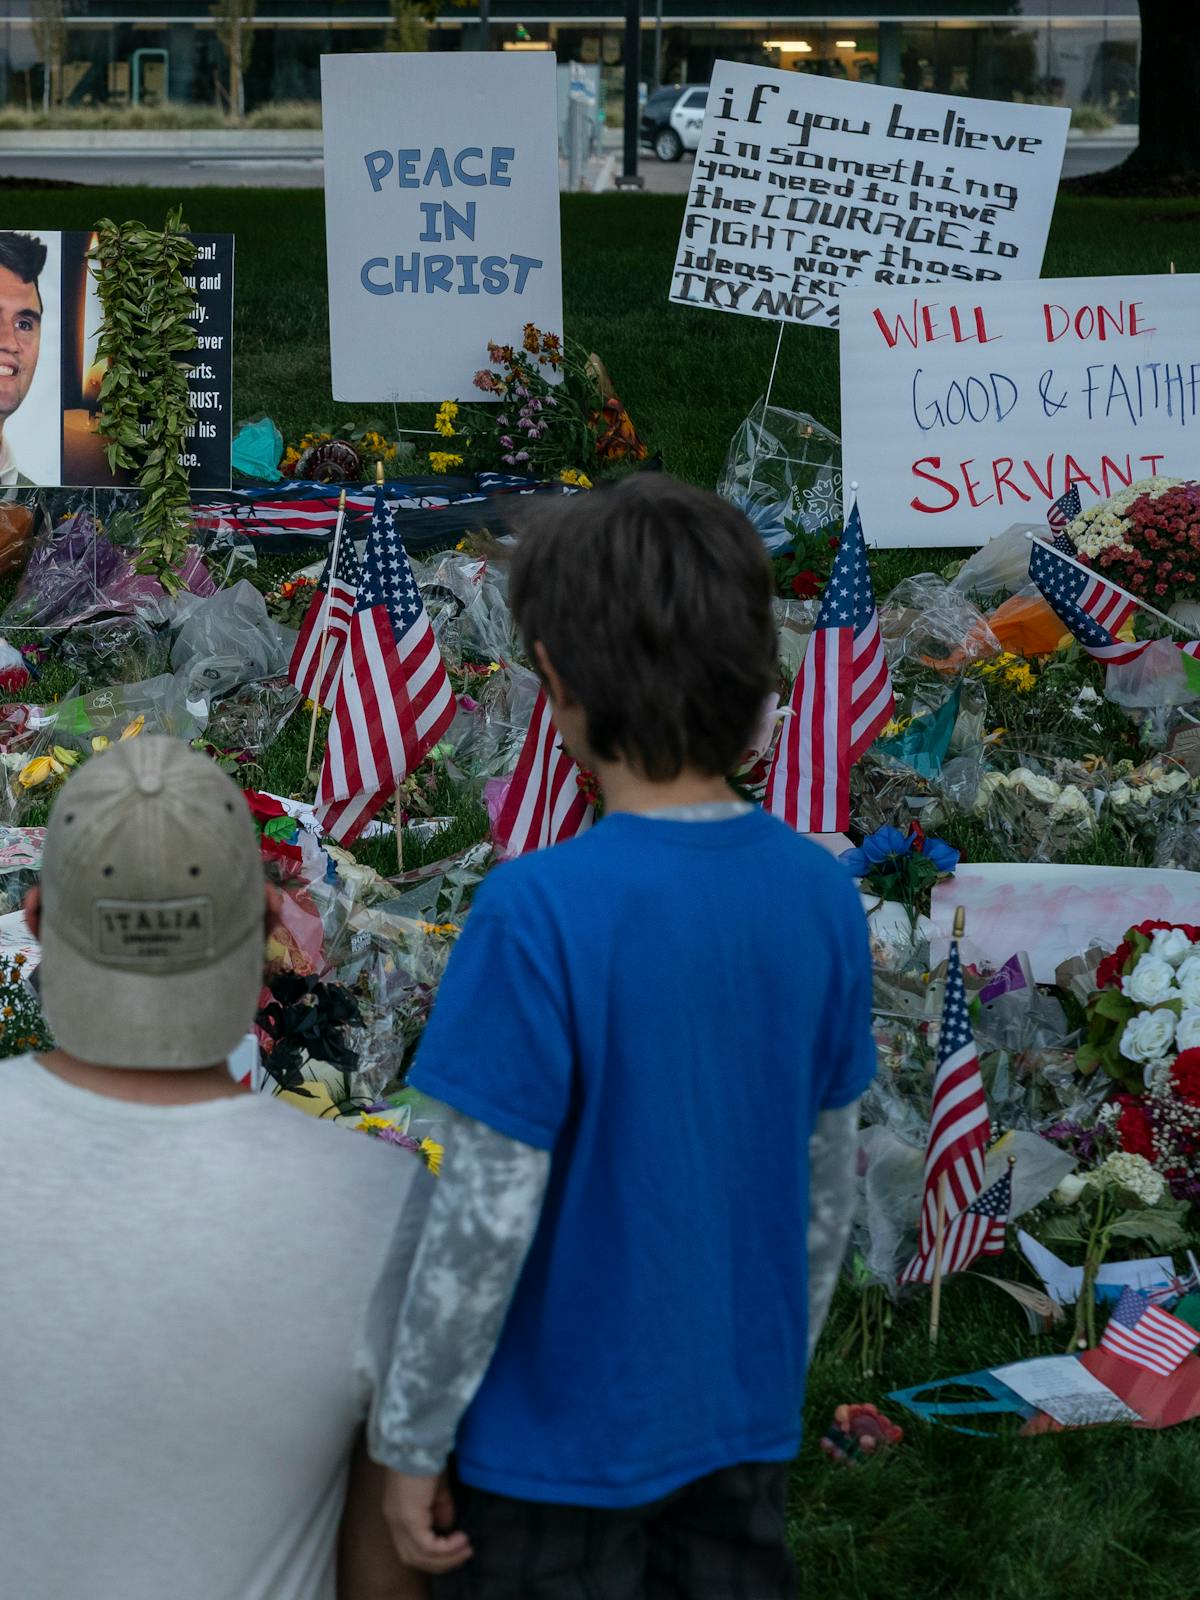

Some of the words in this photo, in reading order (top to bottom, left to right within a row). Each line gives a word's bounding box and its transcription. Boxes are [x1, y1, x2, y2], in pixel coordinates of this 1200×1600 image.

[714, 83, 780, 124] if
[787, 109, 871, 147] you
[886, 103, 1043, 155] believe
[364, 147, 515, 192] PEACE
[696, 159, 761, 182] you
[768, 170, 854, 198] need
[862, 182, 899, 206] to
[909, 191, 996, 225] have
[705, 130, 761, 161] in
[767, 146, 1019, 212] something
[419, 200, 476, 242] IN
[685, 214, 807, 251] FIGHT
[805, 234, 873, 263] for
[689, 184, 756, 214] the
[761, 194, 971, 251] COURAGE
[970, 230, 1019, 258] to
[200, 273, 221, 290] and
[360, 252, 543, 295] CHRIST
[793, 256, 864, 278] NOT
[874, 269, 944, 285] RU
[752, 288, 825, 320] AND
[873, 299, 1003, 348] WELL
[1043, 300, 1157, 342] DONE
[913, 368, 1018, 430] GOOD
[1039, 369, 1067, 417] &
[199, 421, 216, 438] his
[910, 454, 1164, 514] SERVANT
[104, 911, 202, 932] ITALIA
